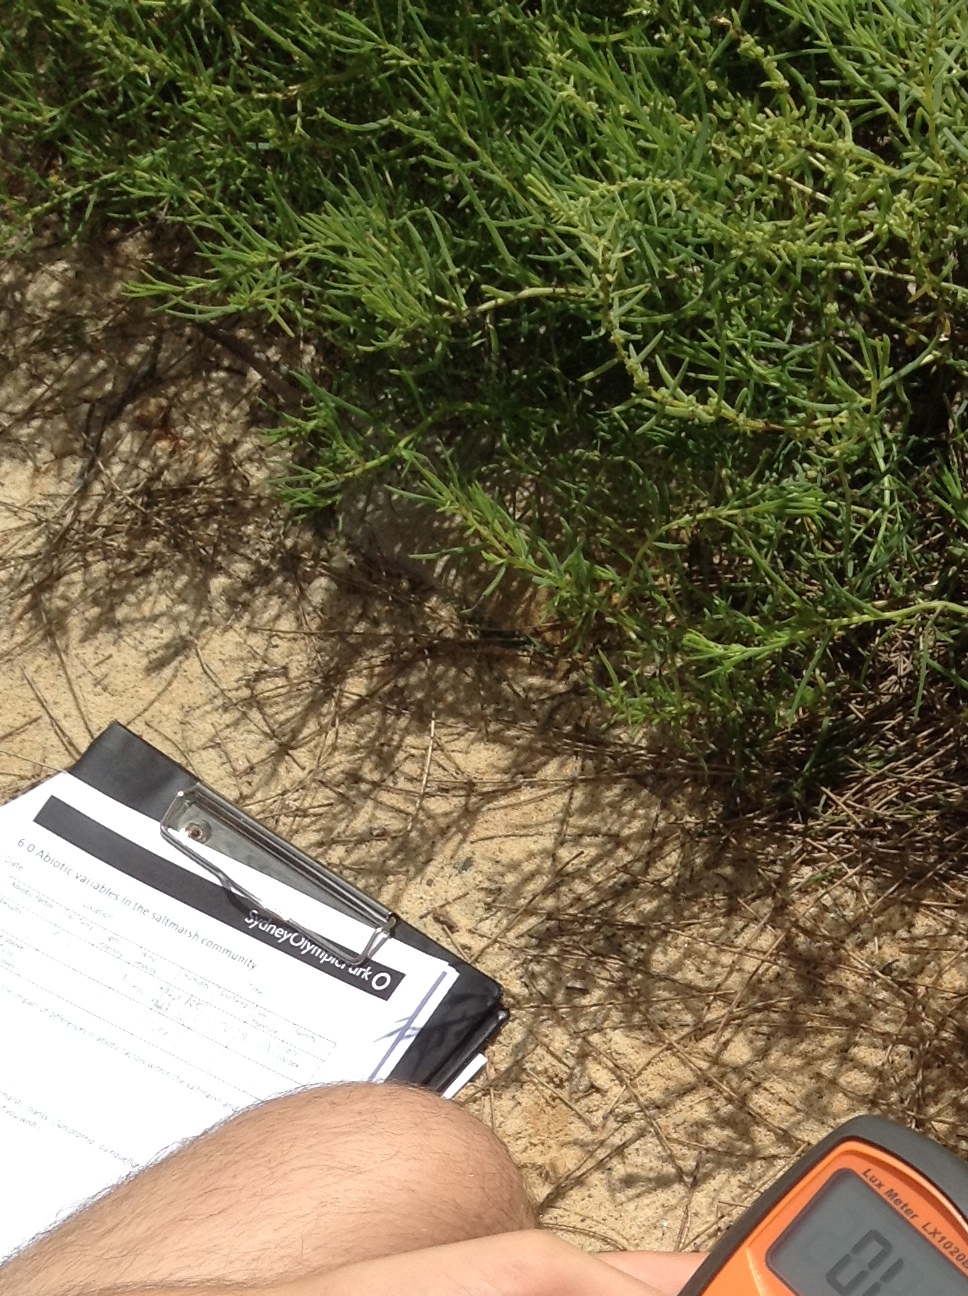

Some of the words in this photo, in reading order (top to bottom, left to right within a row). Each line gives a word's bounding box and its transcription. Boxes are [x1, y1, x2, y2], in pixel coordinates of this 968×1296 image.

[34, 848, 74, 876] Abiotic
[74, 871, 120, 901] variables
[121, 896, 132, 907] in
[132, 901, 150, 916] the
[150, 911, 200, 941] saltmarsh
[199, 936, 258, 971] community
[861, 1167, 886, 1190] Lux
[883, 1187, 920, 1220] Meter
